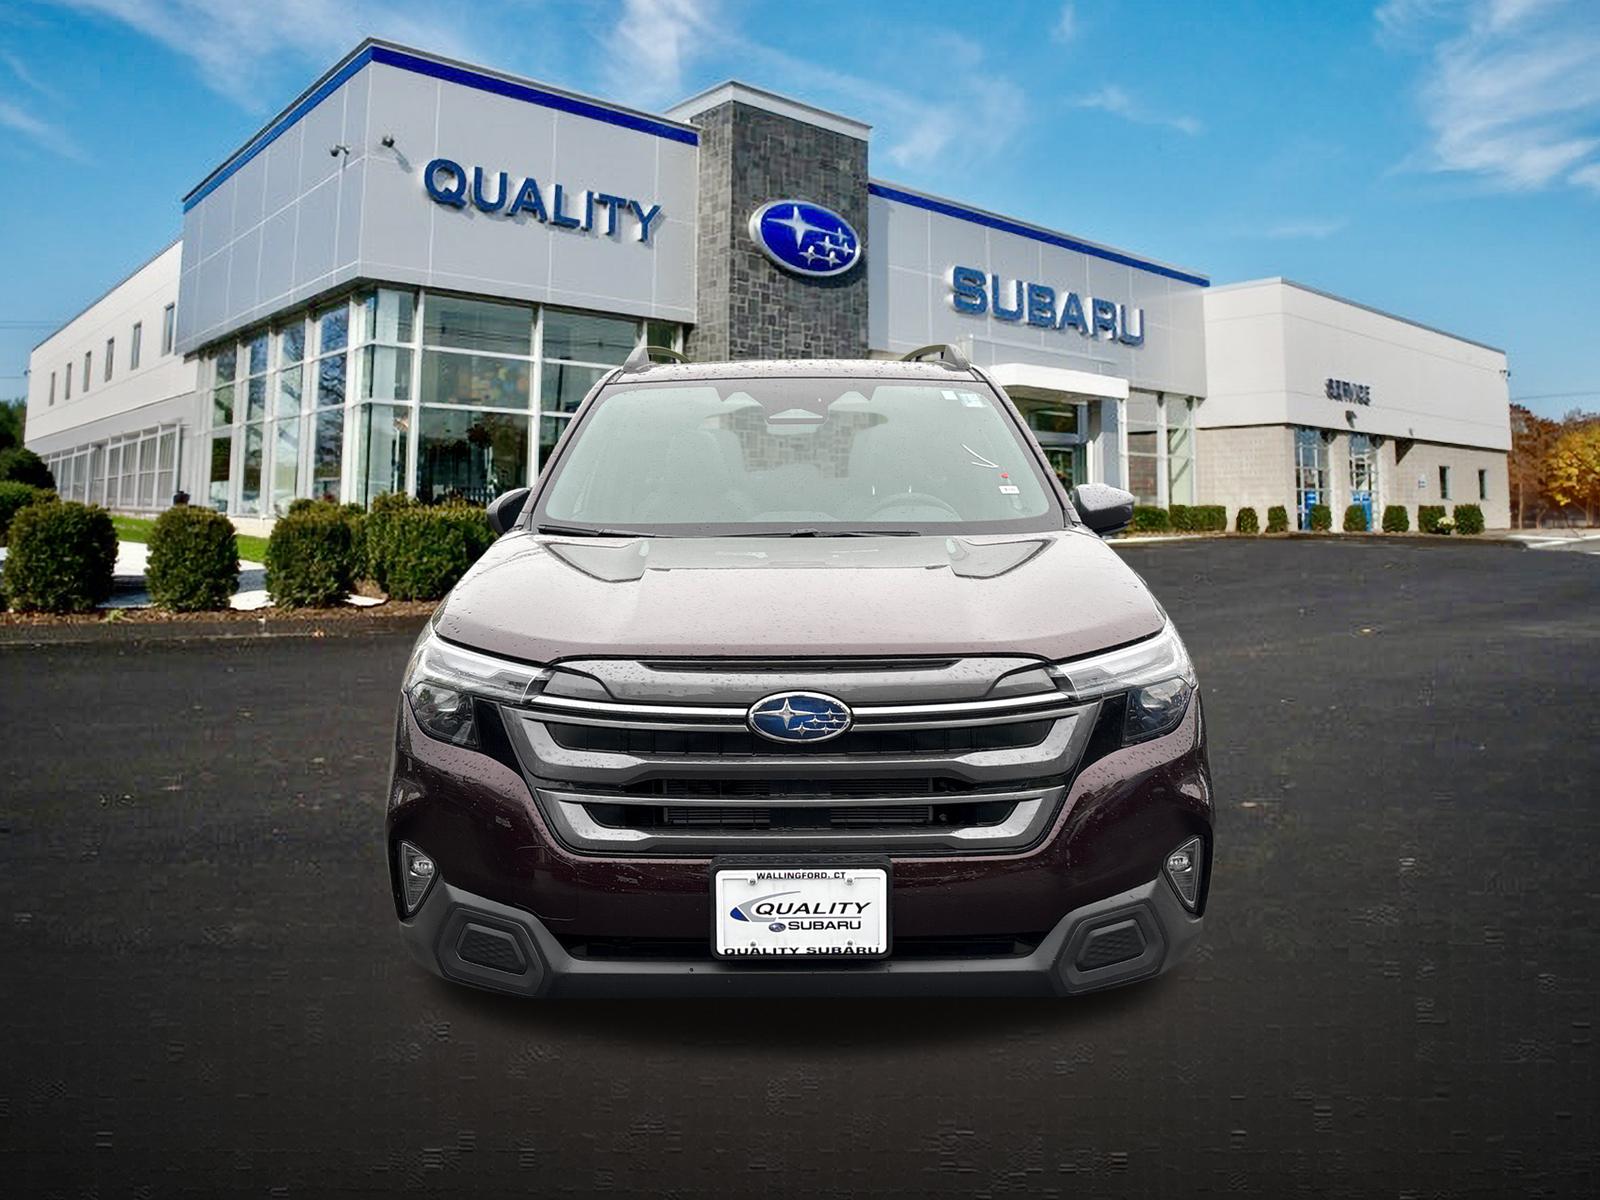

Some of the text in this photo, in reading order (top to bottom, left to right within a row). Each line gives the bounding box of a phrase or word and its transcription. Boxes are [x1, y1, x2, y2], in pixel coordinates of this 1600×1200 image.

[424, 158, 661, 242] QUALITY
[951, 265, 1144, 345] SUBARU
[1325, 378, 1371, 406] SERVICE
[755, 902, 871, 915] QUALITY
[788, 921, 861, 930] SUBARU
[724, 947, 799, 955] QUALITY
